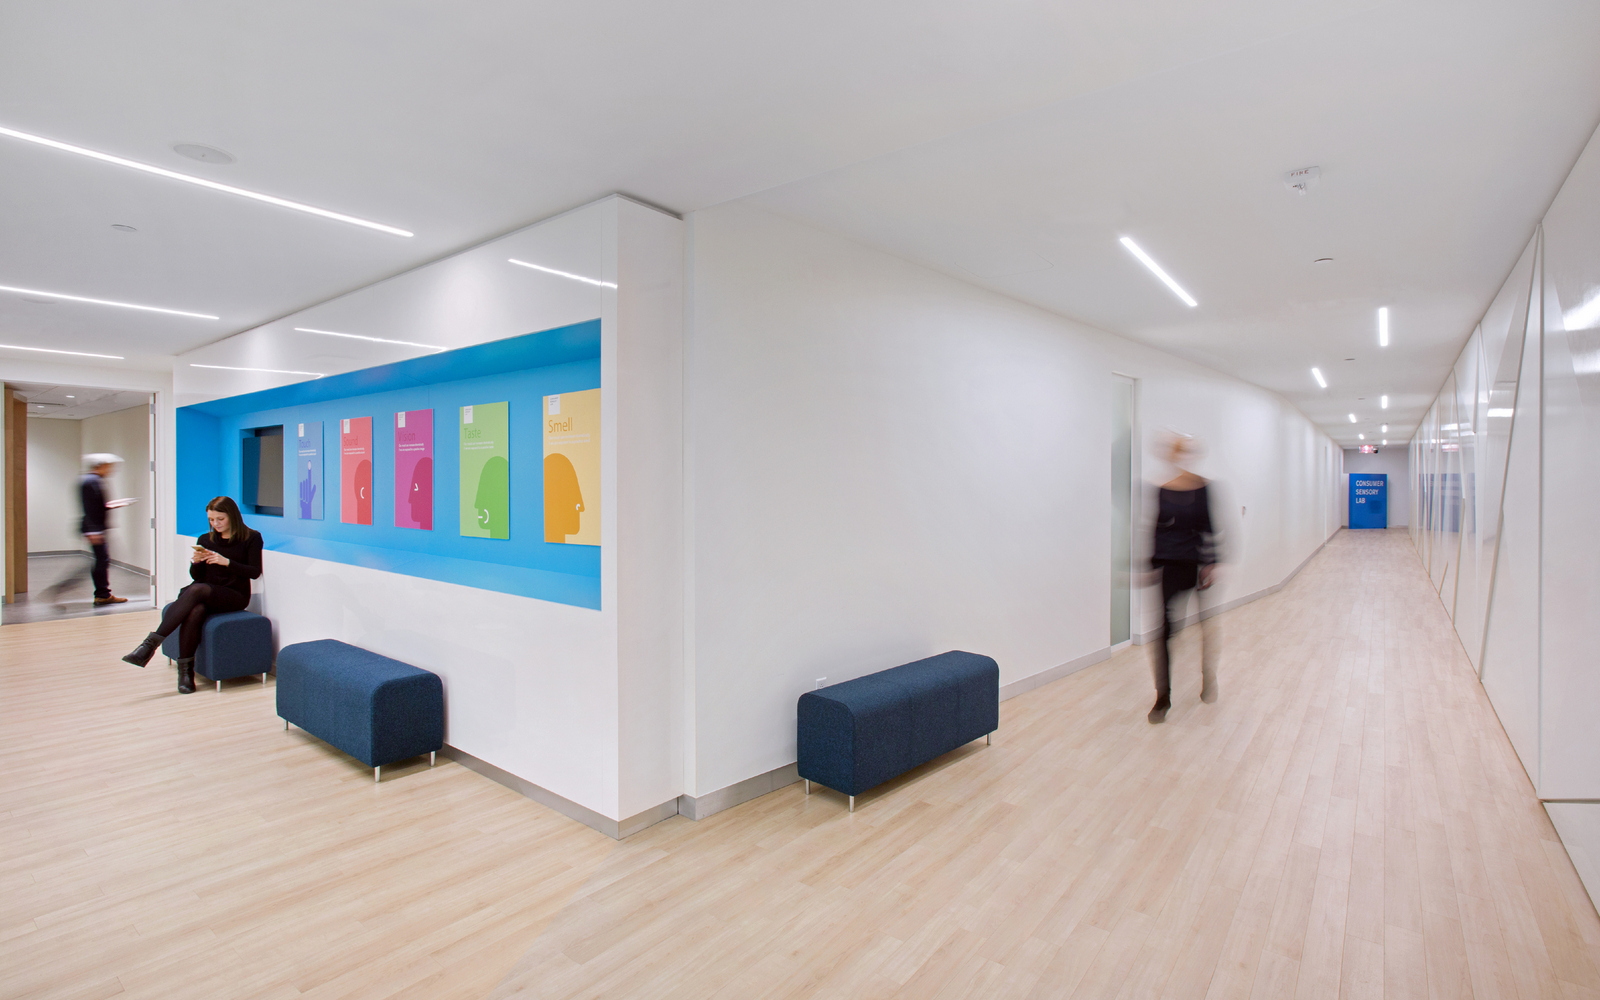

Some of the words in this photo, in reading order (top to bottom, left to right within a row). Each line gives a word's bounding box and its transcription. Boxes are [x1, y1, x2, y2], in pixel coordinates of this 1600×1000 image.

[1291, 169, 1309, 177] FIRE
[548, 416, 573, 434] Smell
[397, 430, 416, 442] Vision
[463, 427, 481, 439] Taste
[298, 439, 311, 448] Touch
[343, 435, 358, 447] Sound
